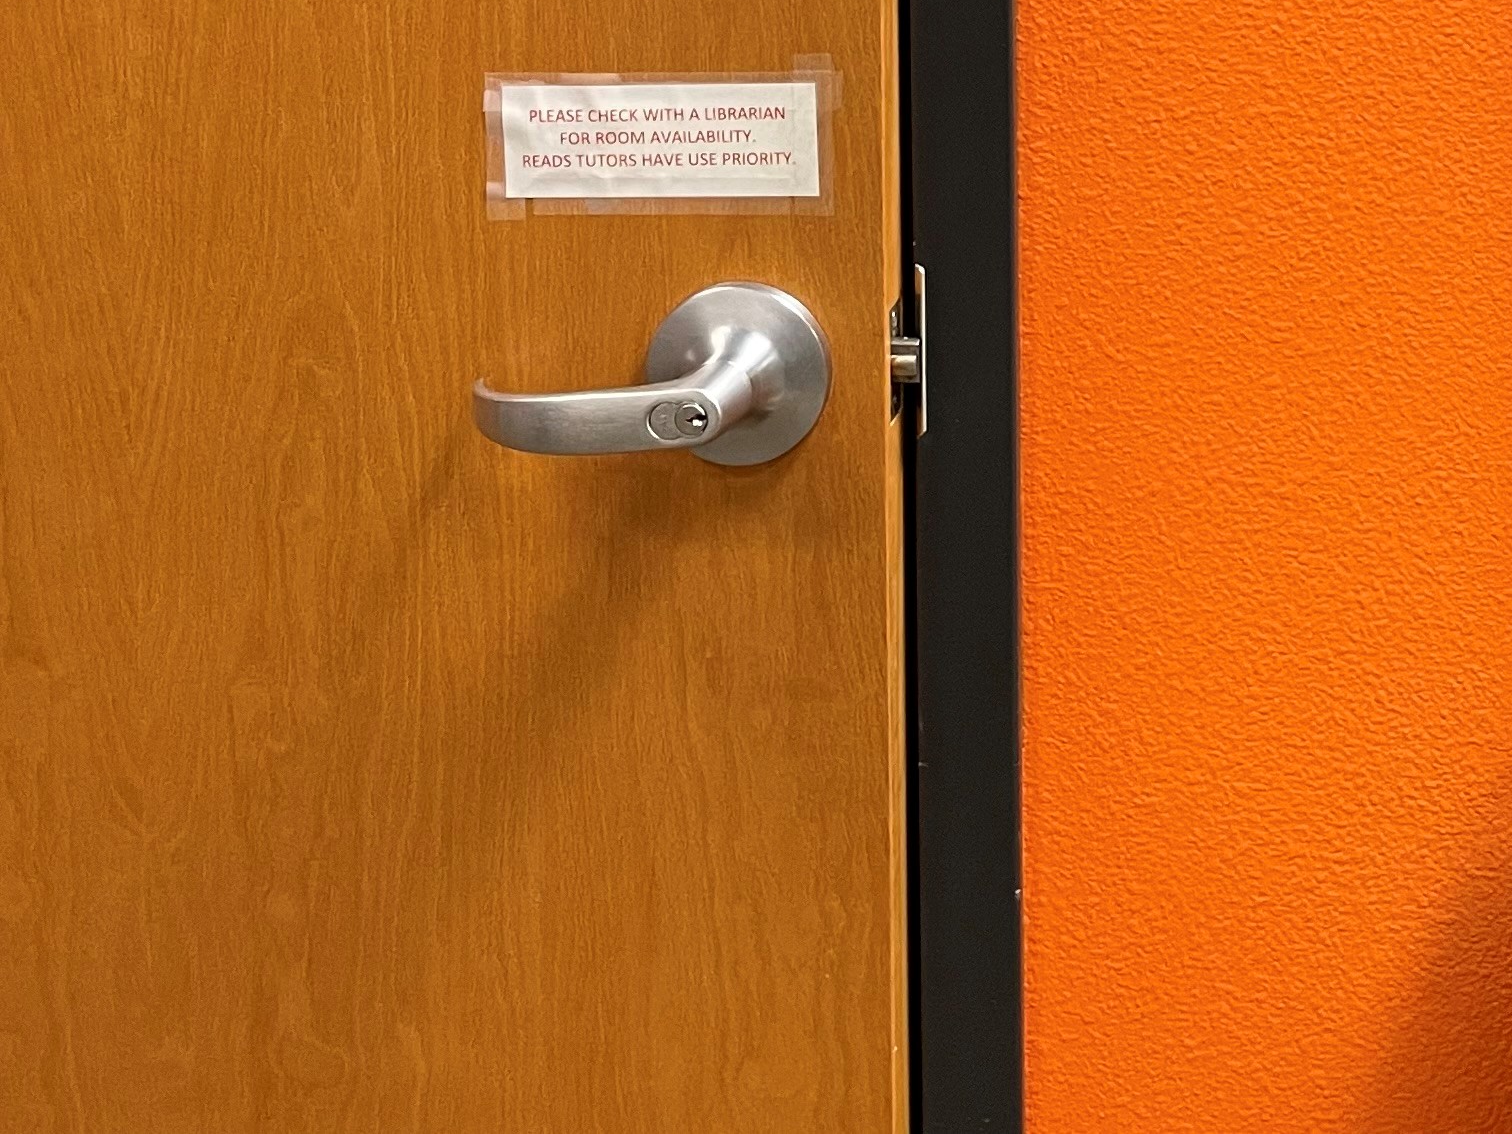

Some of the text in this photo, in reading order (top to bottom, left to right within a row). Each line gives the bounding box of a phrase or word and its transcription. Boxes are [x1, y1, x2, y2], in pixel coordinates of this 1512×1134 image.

[529, 106, 786, 123] PLEASE CHECK WITH A LIBRARIAN
[560, 129, 757, 145] FOR ROOM AVAILABILITY.
[522, 151, 797, 168] READS TUTORS HAVE USE PRIORITY.
